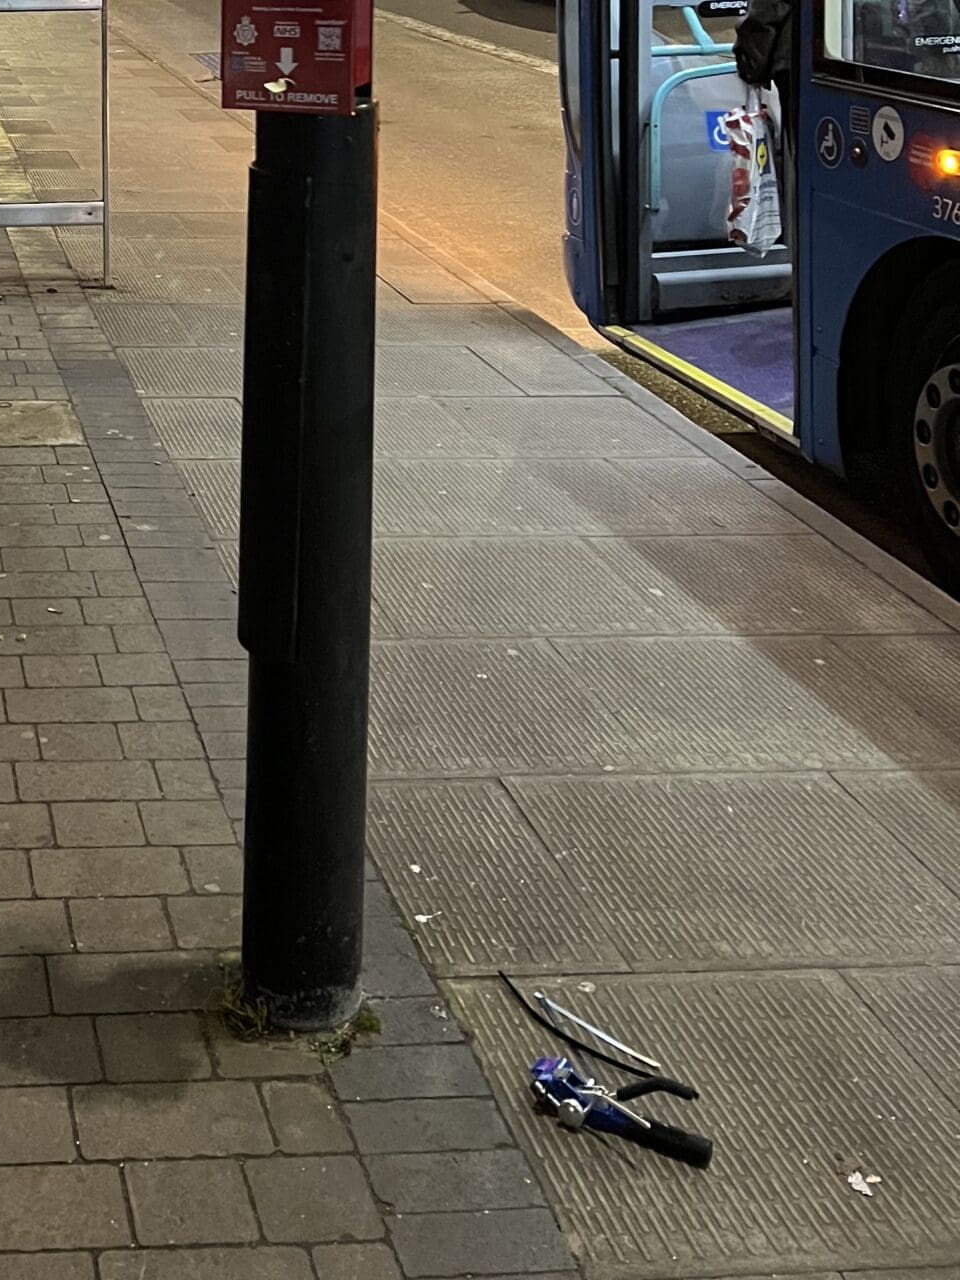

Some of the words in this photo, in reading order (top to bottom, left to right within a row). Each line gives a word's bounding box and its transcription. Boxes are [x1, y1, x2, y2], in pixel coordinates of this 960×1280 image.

[275, 26, 298, 37] NHS
[236, 90, 266, 100] PULL
[269, 91, 284, 101] TO
[287, 92, 338, 104] REMOVE
